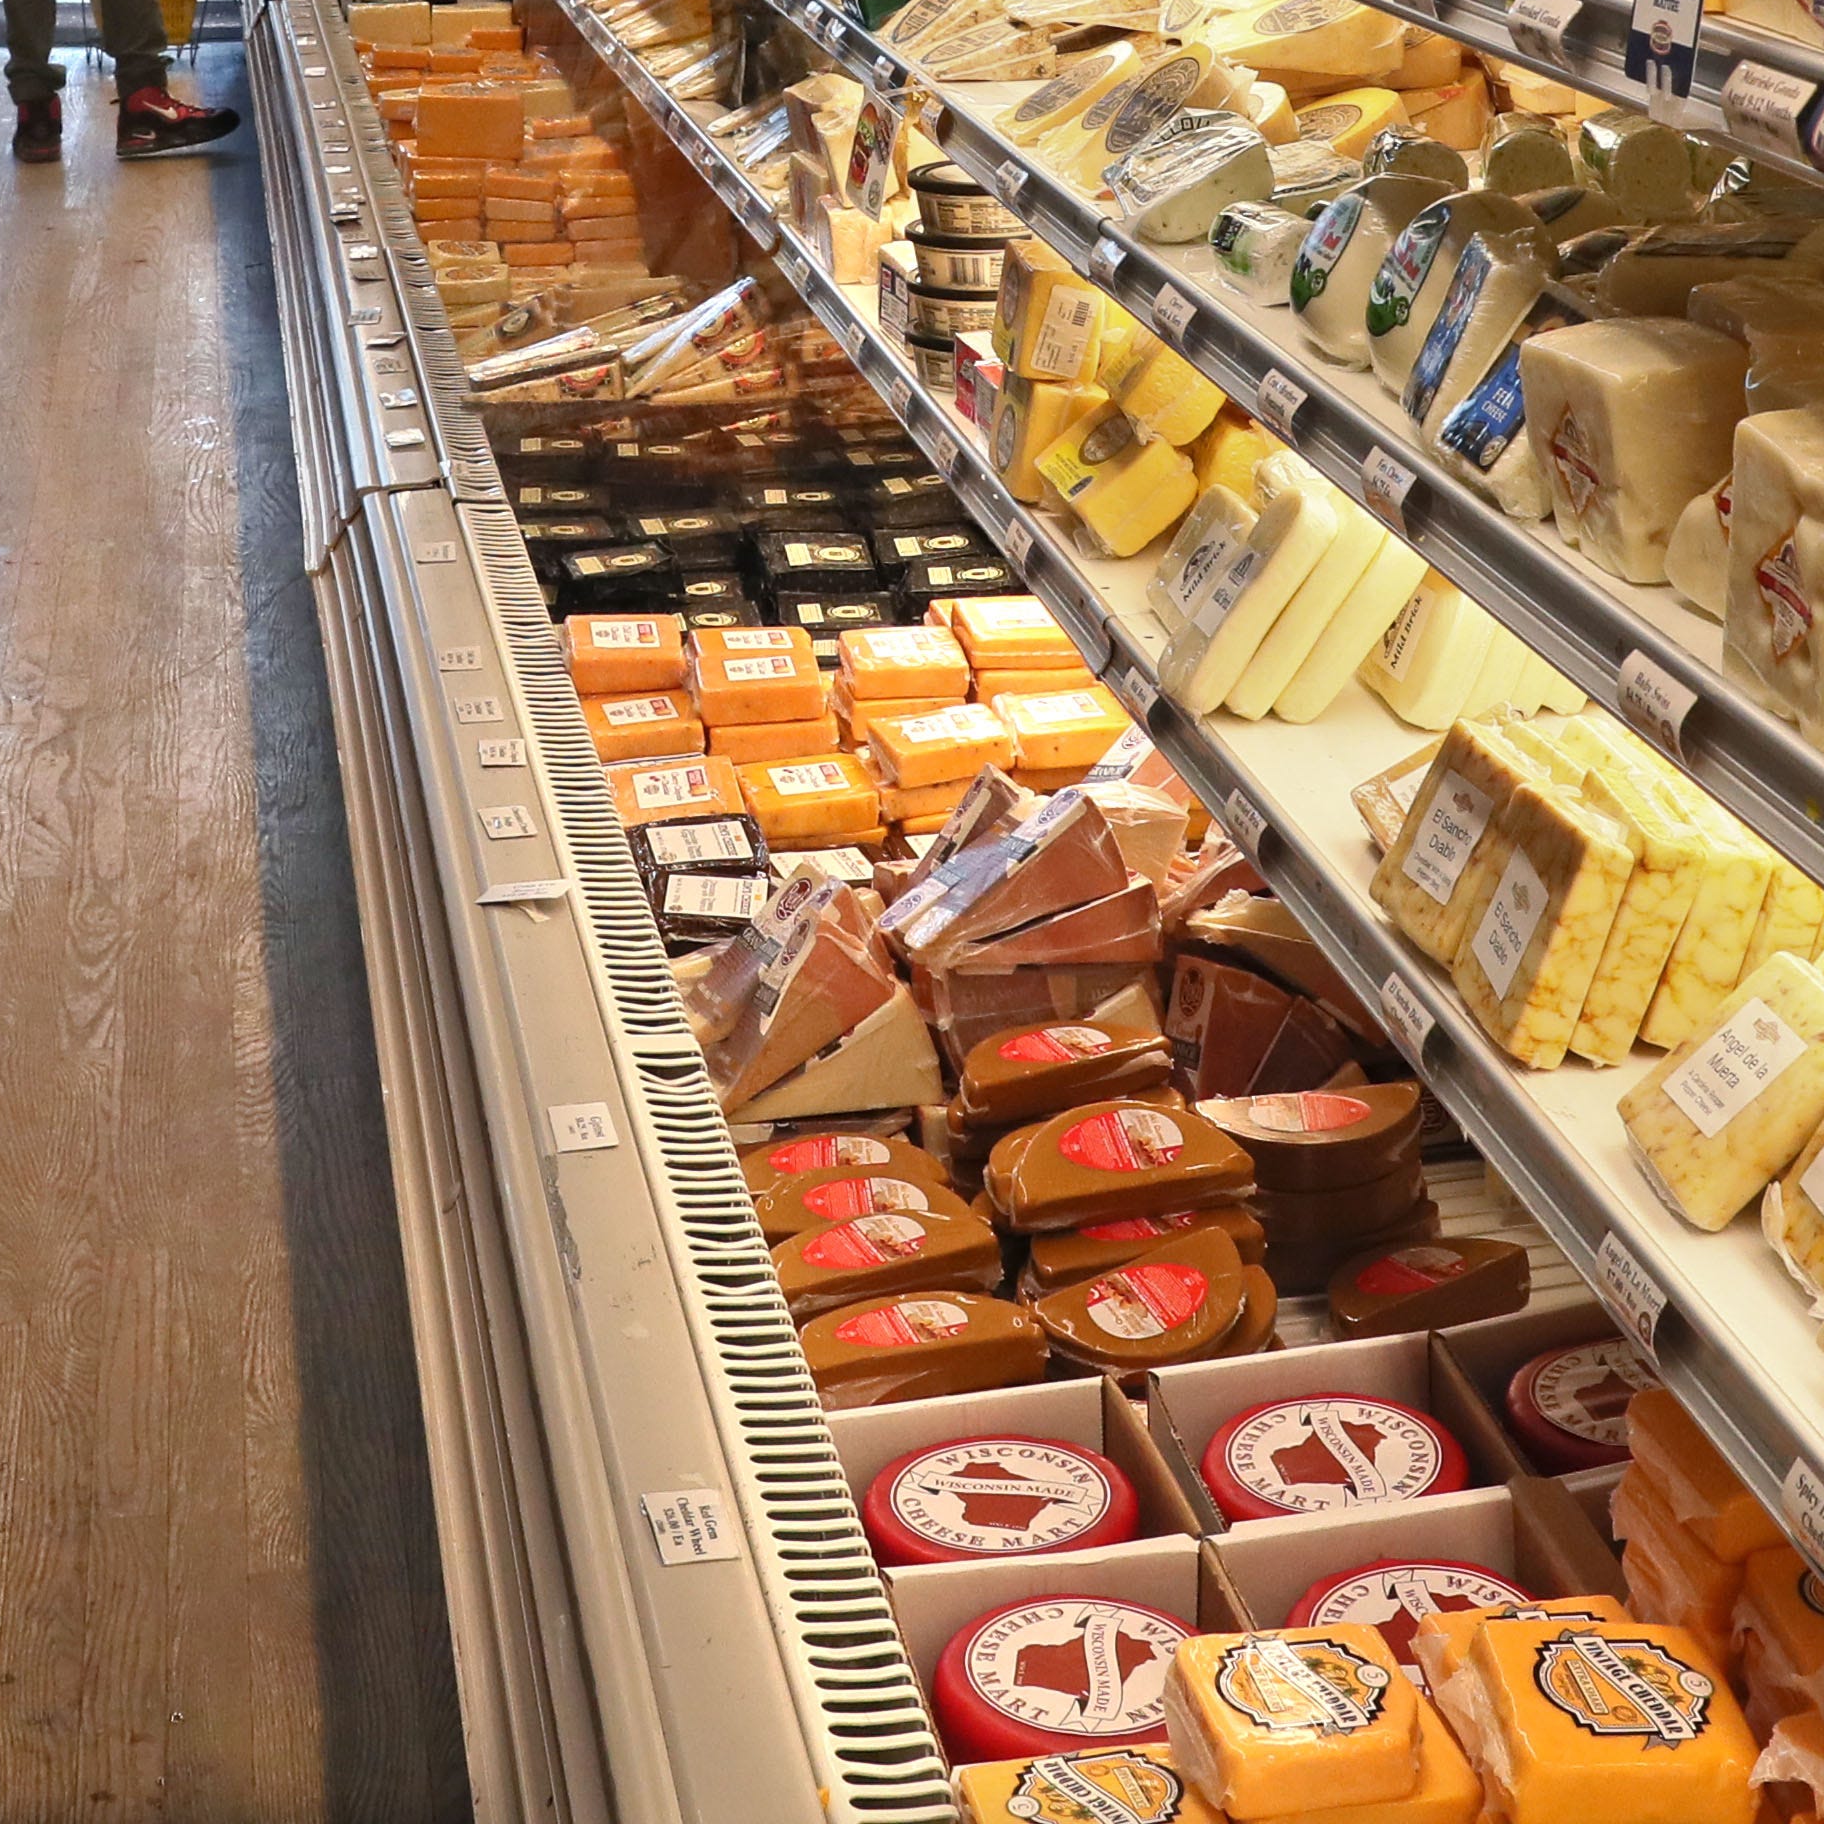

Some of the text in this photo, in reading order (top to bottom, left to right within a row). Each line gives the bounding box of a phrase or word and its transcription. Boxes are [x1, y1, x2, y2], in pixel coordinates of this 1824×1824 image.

[1481, 401, 1509, 423] CHEESE
[1492, 387, 1514, 410] FETA
[1182, 539, 1227, 603] Mild Brick
[1389, 595, 1424, 670] Mild Brick
[1428, 833, 1457, 862] Diablo
[1432, 808, 1473, 847] El Sancho
[1499, 913, 1523, 953] Sancho
[1718, 1027, 1769, 1081] Angel de la
[936, 1446, 1095, 1486] WISCONSIN
[1234, 1413, 1288, 1473] CHEESE
[1316, 1415, 1377, 1495] WISCONSIN MADE
[1356, 1406, 1431, 1495] WISCONSIN
[933, 1478, 1077, 1499] WISCONSIN MADE
[1248, 1476, 1332, 1511] MART
[1794, 1474, 1822, 1514] Spicy
[902, 1496, 986, 1548] CHEESE
[1001, 1516, 1084, 1550] MART
[975, 1606, 1065, 1663] CHEESE
[1091, 1622, 1113, 1714] WISCONSIN MADE
[1582, 1639, 1687, 1737] VINTAGE CHEDDAR
[977, 1669, 1051, 1722] MART
